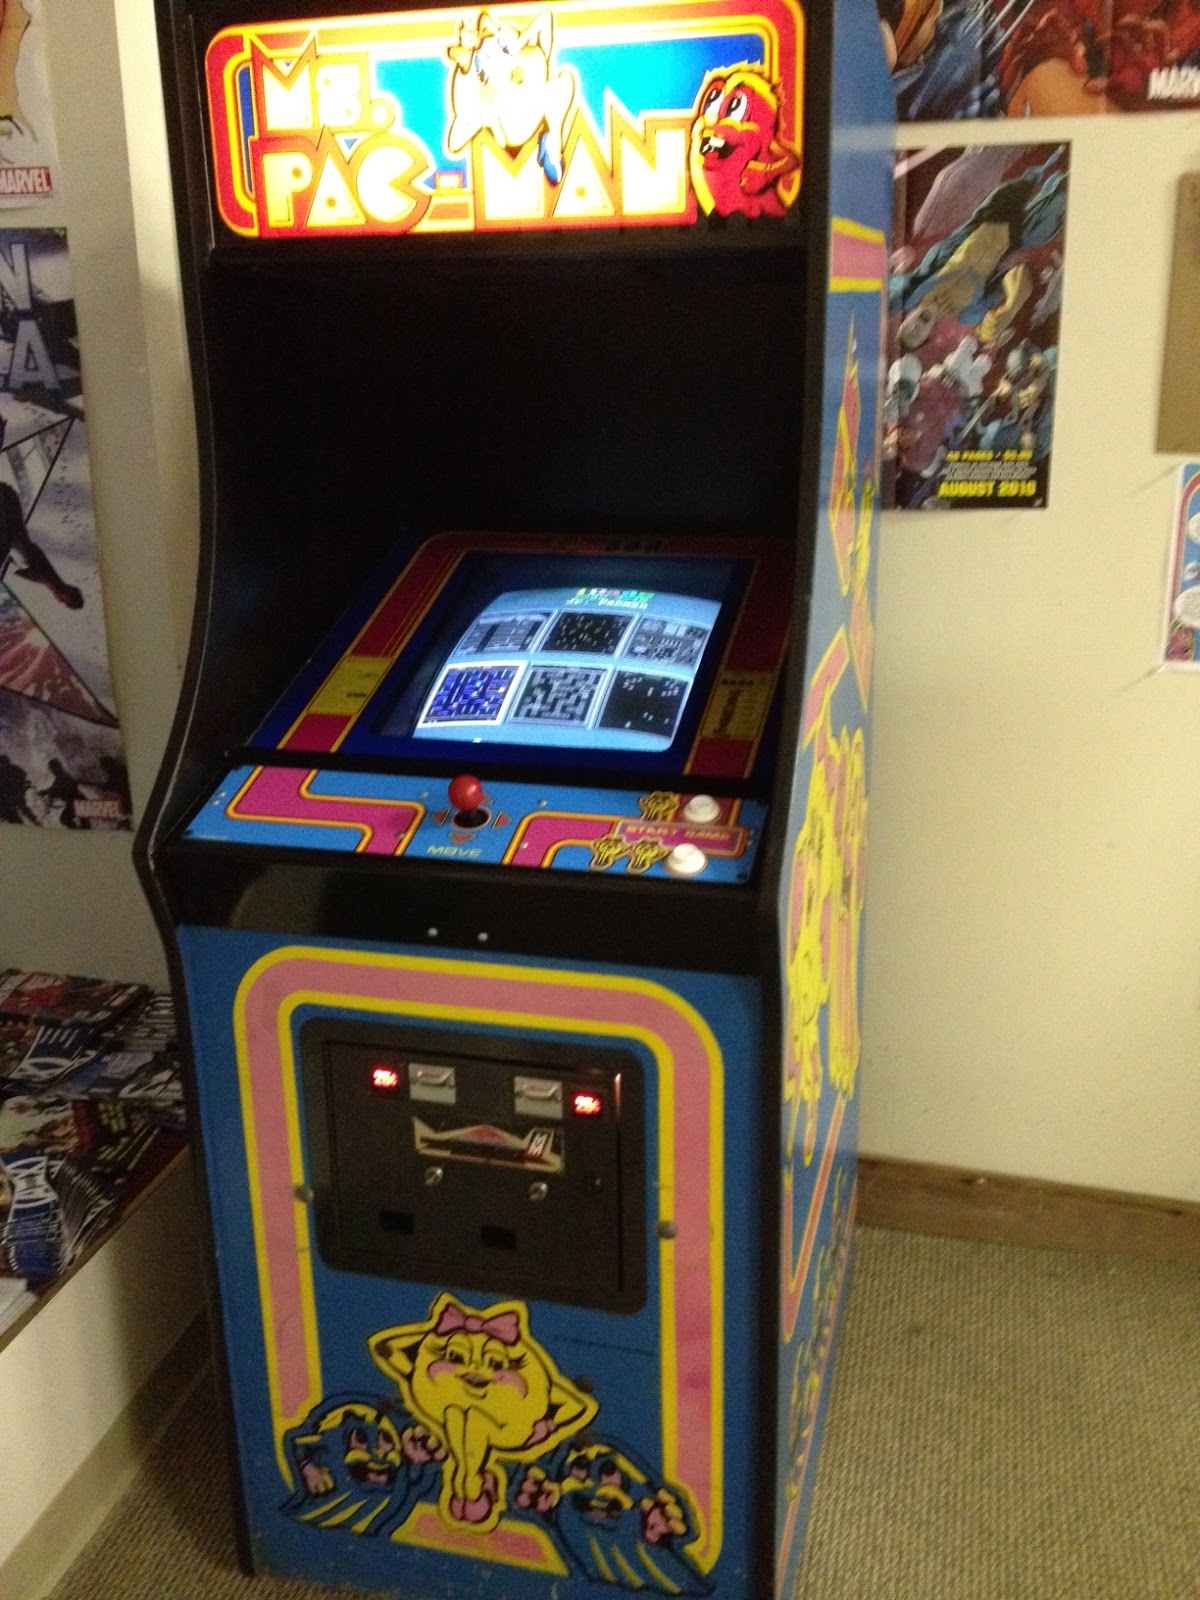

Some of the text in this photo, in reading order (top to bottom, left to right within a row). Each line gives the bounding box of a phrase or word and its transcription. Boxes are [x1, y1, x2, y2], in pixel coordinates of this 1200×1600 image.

[938, 479, 1037, 497] AUGUST 2010
[626, 824, 732, 841] START GAME
[426, 845, 483, 858] MOVE
